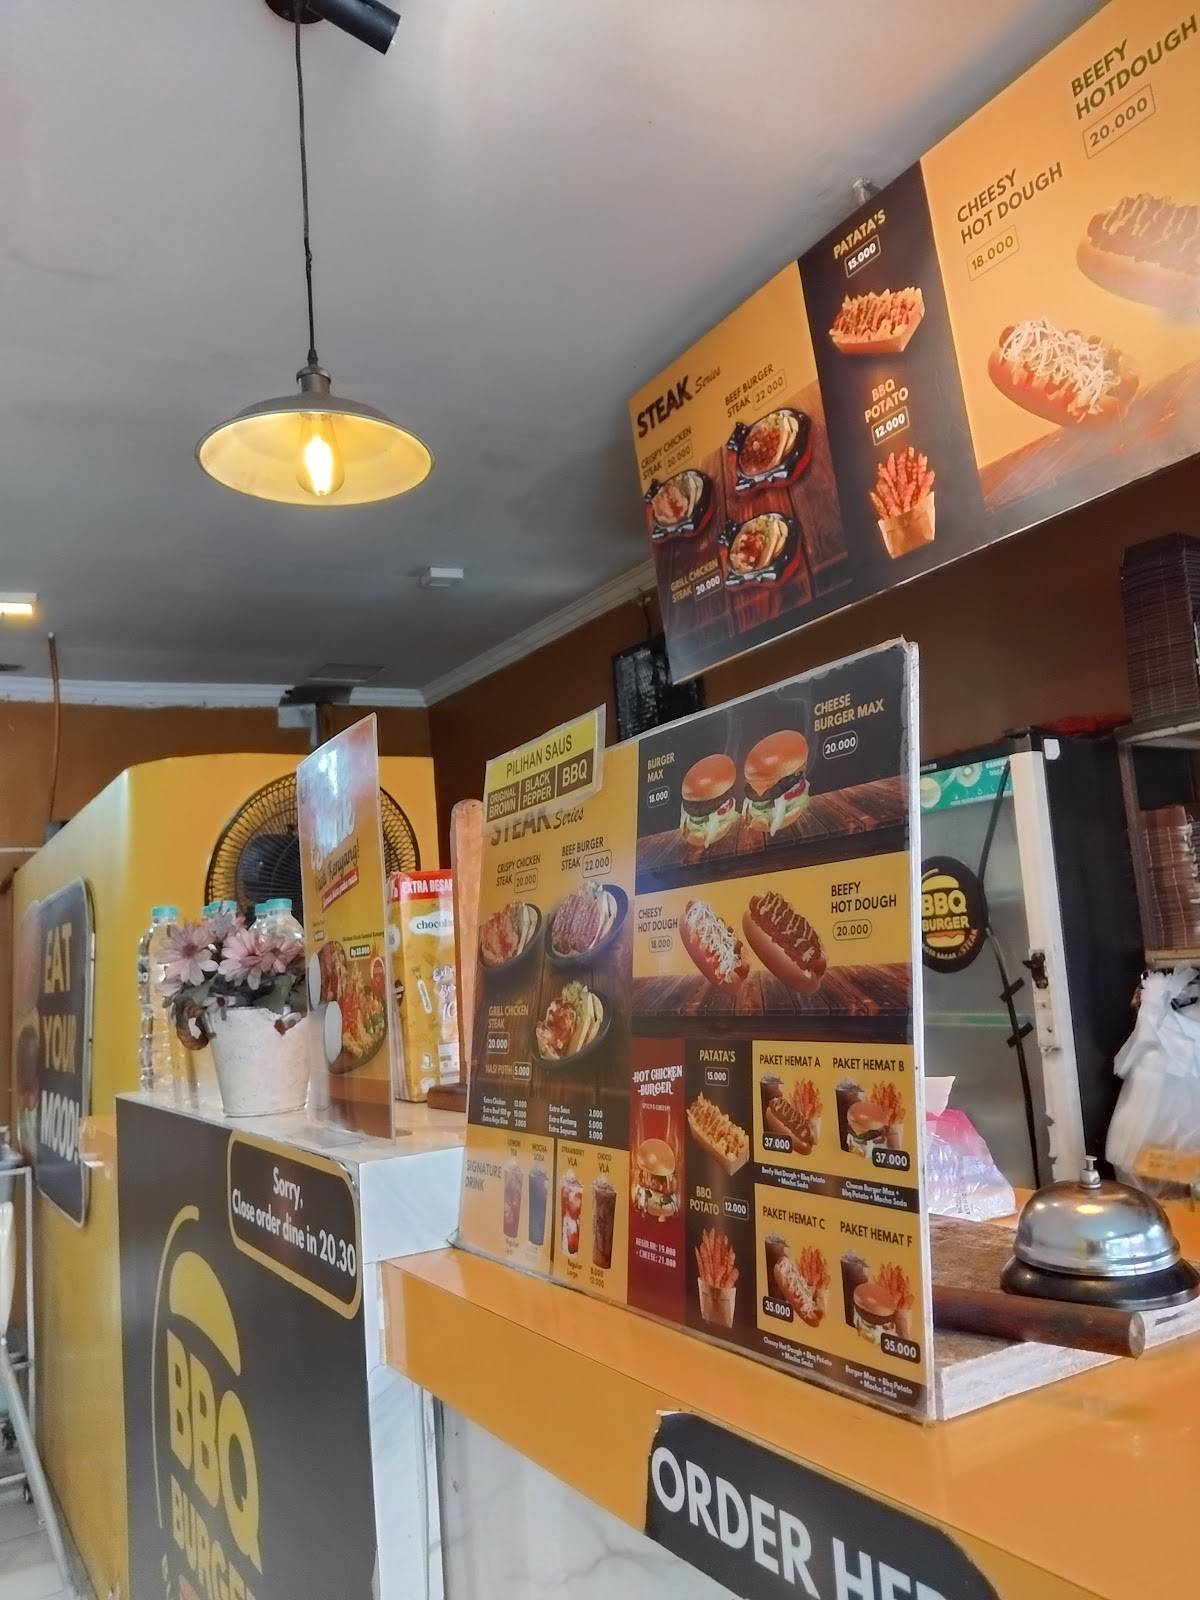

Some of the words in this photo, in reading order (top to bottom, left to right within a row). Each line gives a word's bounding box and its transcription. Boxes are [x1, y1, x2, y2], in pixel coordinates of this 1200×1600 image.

[1071, 38, 1127, 97] BEEFY
[1076, 14, 1198, 120] HOTDOUGH
[1090, 97, 1147, 148] 20.000
[957, 168, 1016, 222] CHEESY
[961, 209, 993, 244] HOT
[997, 161, 1063, 219] DOUGH
[833, 209, 886, 259] PATATA'S
[848, 243, 876, 270] 15.000
[972, 235, 1013, 270] 18.000
[724, 387, 742, 406] BEEF
[742, 363, 774, 394] BURGER
[872, 379, 895, 401] BBQ
[637, 375, 693, 438] STEAK
[727, 394, 751, 418] STEAK
[754, 377, 784, 403] 22.000
[864, 387, 908, 423] POTATO
[875, 413, 905, 438] 12.000
[641, 448, 662, 469] CRISPY
[663, 426, 692, 455] CHICKEN
[642, 462, 662, 480] STEAK
[696, 576, 720, 595] 20.000
[814, 693, 851, 716] CHEESE
[814, 709, 855, 733] BURGER
[857, 698, 885, 719] MAX
[825, 736, 856, 754] 20.000
[506, 748, 543, 779] PILIHAN
[545, 734, 573, 761] SAUS
[647, 752, 675, 771] BURGER
[525, 771, 550, 791] BLACK
[562, 759, 588, 788] BBQ
[647, 770, 664, 784] MAX
[490, 787, 516, 804] ORIGINAL
[522, 786, 551, 806] PEPPER
[489, 801, 516, 819] BROWN
[552, 807, 584, 830] Series
[561, 841, 576, 857] BEEF
[577, 836, 604, 853] BURGER
[497, 860, 515, 874] CRISPY
[516, 854, 541, 869] CHICKEN
[561, 858, 581, 871] STEAK
[585, 856, 609, 872] 22.000
[402, 880, 428, 894] EXTRA
[496, 875, 513, 887] STEAK
[516, 875, 536, 887] 20.000
[831, 881, 861, 897] BEEFY
[831, 899, 853, 914] HOT
[855, 894, 897, 911] DOUGH
[922, 889, 967, 916] BBQ
[638, 905, 663, 920] CHEESY
[638, 920, 652, 933] HOT
[652, 918, 678, 931] DOUGH
[836, 923, 869, 937] 20.000
[922, 915, 970, 932] BURGER
[43, 922, 73, 994] EAT
[489, 1006, 504, 1016] GRILL
[504, 1004, 528, 1016] CHICKEN
[488, 1018, 505, 1030] STEAK
[43, 1014, 77, 1075] YOUR
[488, 1038, 508, 1049] 20.000
[700, 1049, 736, 1062] PATATA'S
[759, 1054, 783, 1066] PAKET
[785, 1055, 812, 1067] HEMAT
[814, 1057, 821, 1067] A
[832, 1058, 860, 1069] PAKET
[863, 1059, 895, 1071] HEMAT
[898, 1061, 905, 1071] B
[514, 1065, 530, 1077] 5.000
[632, 1069, 649, 1082] HOT
[651, 1065, 682, 1081] CHICKEN
[707, 1072, 726, 1082] 15.000
[638, 1081, 674, 1096] BURGER
[40, 1090, 80, 1165] MOOD!
[588, 1120, 603, 1129] 5.000
[588, 1130, 603, 1140] 5.000
[764, 1137, 790, 1150] 37.000
[466, 1160, 502, 1178] SIGNATURE
[875, 1152, 907, 1167] 37.000
[273, 1166, 303, 1211] Sorry,
[796, 1180, 809, 1189] Soda
[810, 1175, 826, 1184] Potato
[696, 1186, 711, 1199] BBQ
[852, 1190, 869, 1200] Potato
[873, 1193, 892, 1205] Mocha
[892, 1197, 908, 1208] Soda
[882, 1186, 895, 1196] Max
[690, 1199, 719, 1215] POTATO
[725, 1202, 746, 1215] 12.000
[763, 1206, 786, 1221] PAKET
[788, 1212, 816, 1229] HEMAT
[819, 1218, 825, 1230] C
[232, 1188, 255, 1223] Close
[256, 1204, 281, 1236] order
[282, 1212, 304, 1249] dine
[306, 1226, 317, 1256] in
[319, 1229, 356, 1277] 20.30
[840, 1221, 868, 1238] PAKET
[871, 1227, 904, 1246] HEMAT
[906, 1235, 913, 1247] F
[765, 1300, 791, 1317] 35.000
[884, 1338, 917, 1358] 35.000
[845, 1365, 863, 1378] Burger
[864, 1372, 876, 1382] Max
[893, 1382, 913, 1394] Potato
[863, 1380, 882, 1393] Mocha
[882, 1387, 898, 1399] Soda
[167, 1328, 262, 1575] BBQ
[651, 1446, 821, 1600] ORDER
